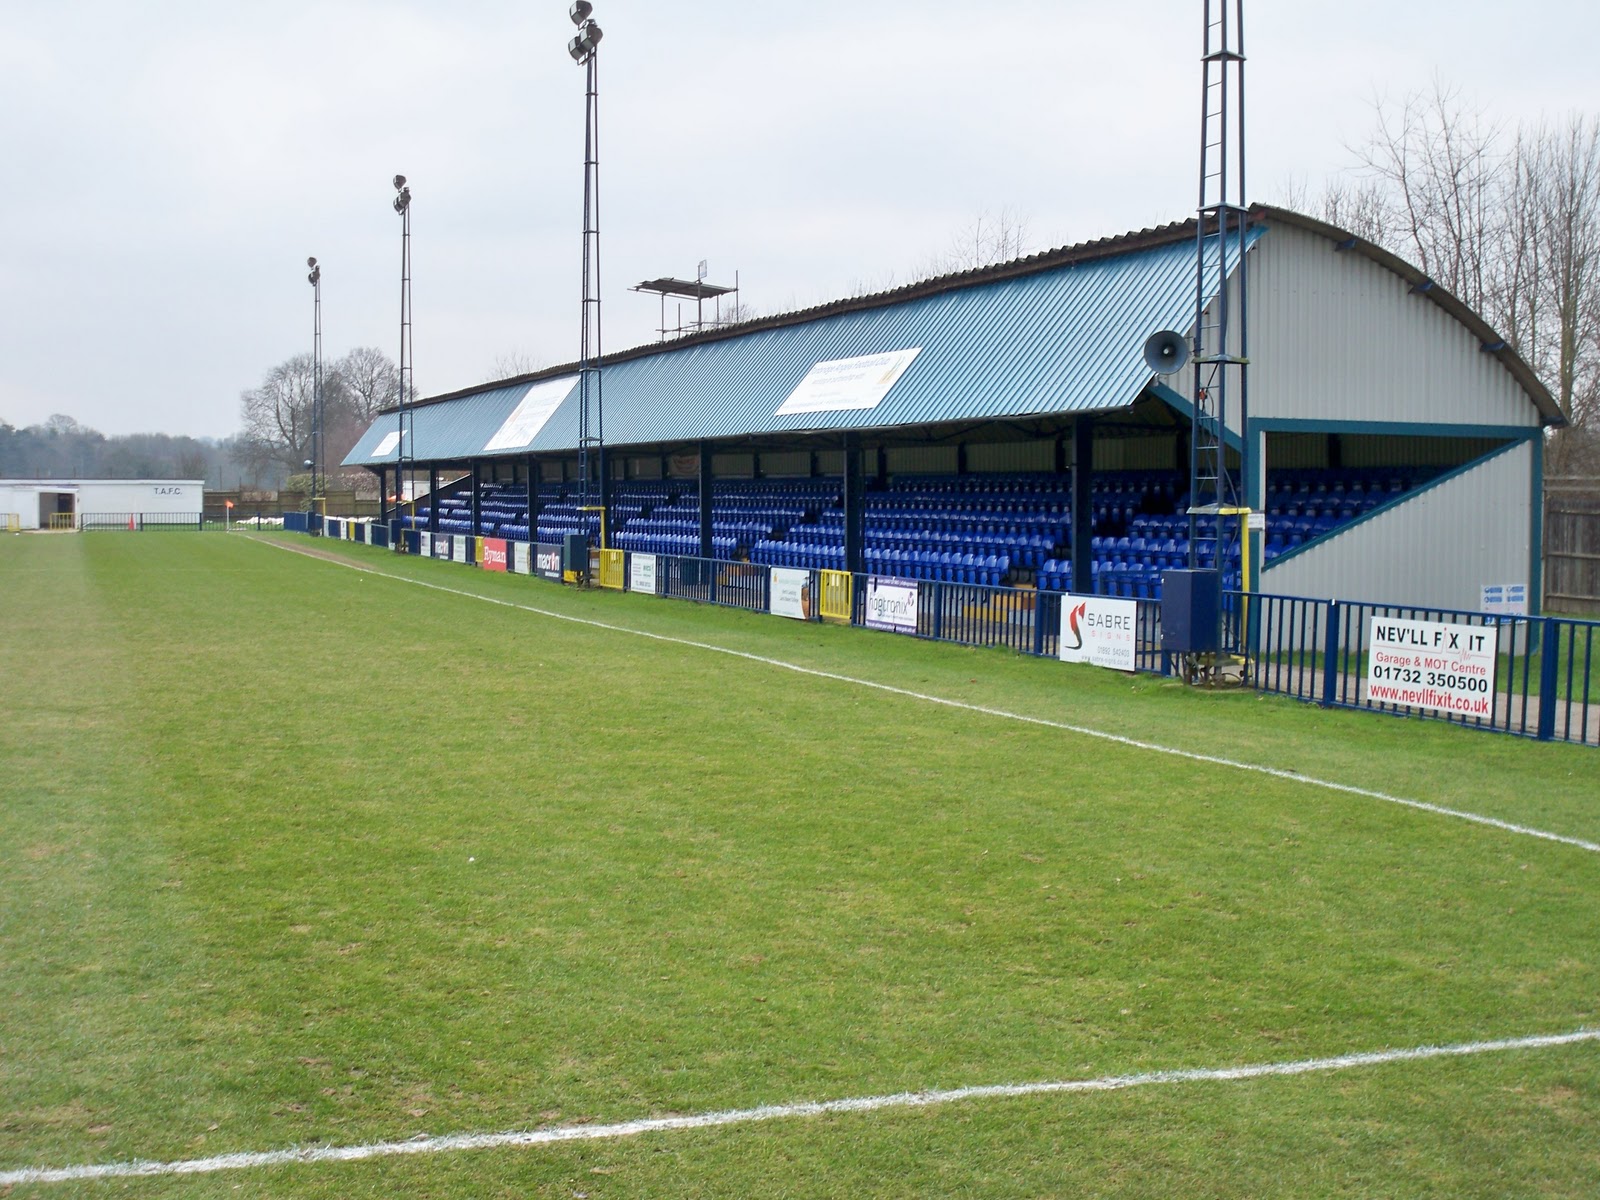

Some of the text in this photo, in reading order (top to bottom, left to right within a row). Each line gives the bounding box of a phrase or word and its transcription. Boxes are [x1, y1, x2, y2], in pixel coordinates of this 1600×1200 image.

[484, 546, 506, 565] Ryman
[1088, 613, 1131, 631] SABRE
[1091, 630, 1131, 642] SIGNS
[1376, 625, 1428, 646] NEV'LL
[1469, 635, 1485, 652] IT
[1376, 652, 1486, 675] Garage & MOT Centre
[1373, 665, 1488, 693] 01732 350500
[1370, 685, 1489, 714] www.nevllfixit.co.uk
